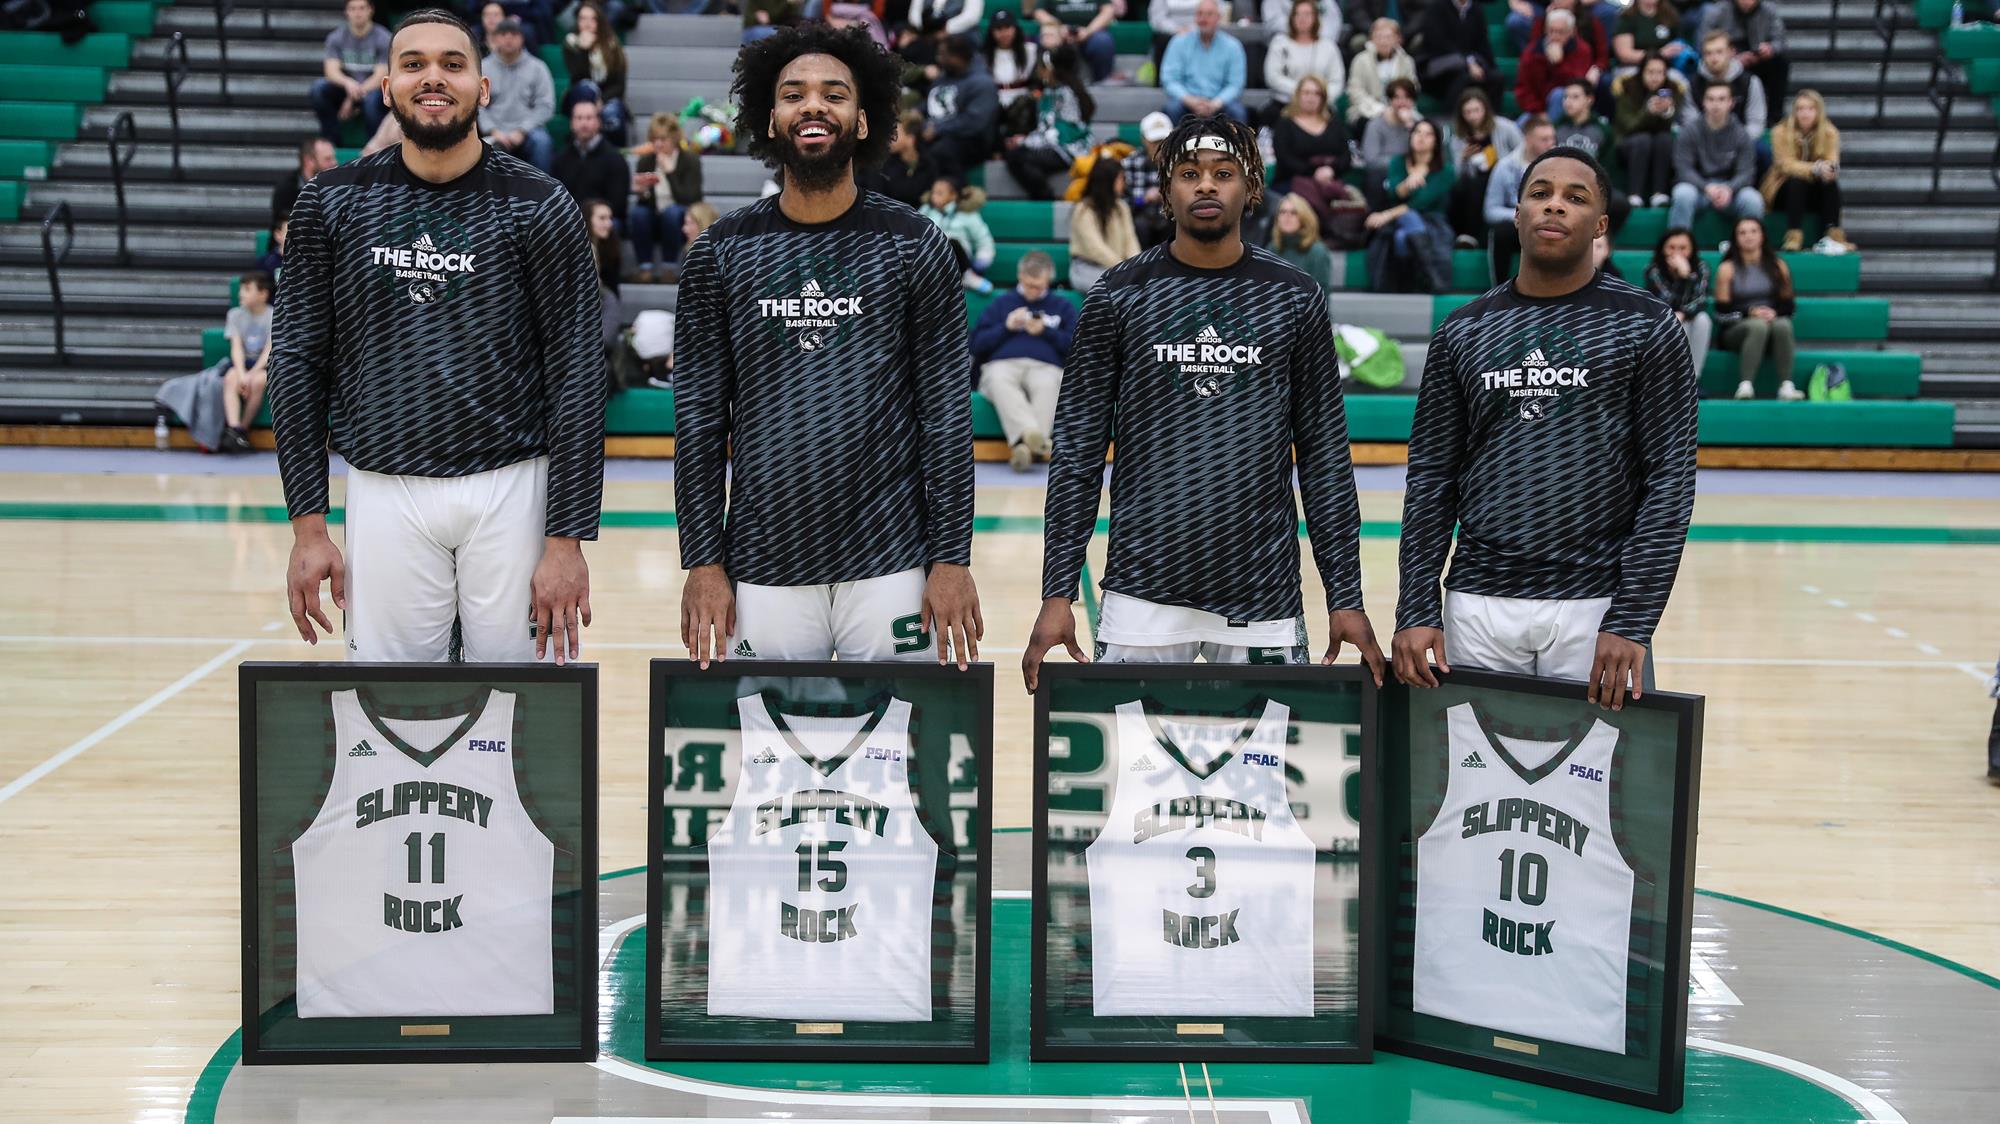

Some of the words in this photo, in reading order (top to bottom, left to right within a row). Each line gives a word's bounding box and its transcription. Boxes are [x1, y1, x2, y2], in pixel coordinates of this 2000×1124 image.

[371, 247, 412, 268] THE
[415, 250, 477, 273] ROCK
[395, 269, 448, 282] BASKETBALL
[758, 298, 801, 317] THE
[804, 297, 863, 317] ROCK
[785, 319, 838, 328] BASKETBALL
[1153, 344, 1196, 362] THE
[1200, 345, 1263, 365] ROCK
[1180, 364, 1236, 374] BASKETBALL
[1481, 369, 1523, 390] THE
[1527, 367, 1590, 388] ROCK
[1509, 388, 1560, 398] BASKETBALL
[468, 740, 506, 753] PSAC
[865, 747, 901, 762] PSAC
[1243, 753, 1279, 767] PSAC
[1568, 763, 1603, 782] PSAC
[356, 781, 493, 829] SLIPPERY
[756, 789, 890, 838] SLIPPERY
[1133, 795, 1267, 845] SLIPPERY
[1461, 798, 1590, 857] SLIPPERY
[404, 832, 445, 884] 11
[794, 840, 848, 893] 15
[1185, 847, 1216, 899] 3
[1498, 848, 1549, 906] 10
[384, 892, 464, 933] ROCK
[780, 901, 859, 944] ROCK
[1163, 908, 1240, 949] ROCK
[1482, 907, 1556, 956] ROCK
